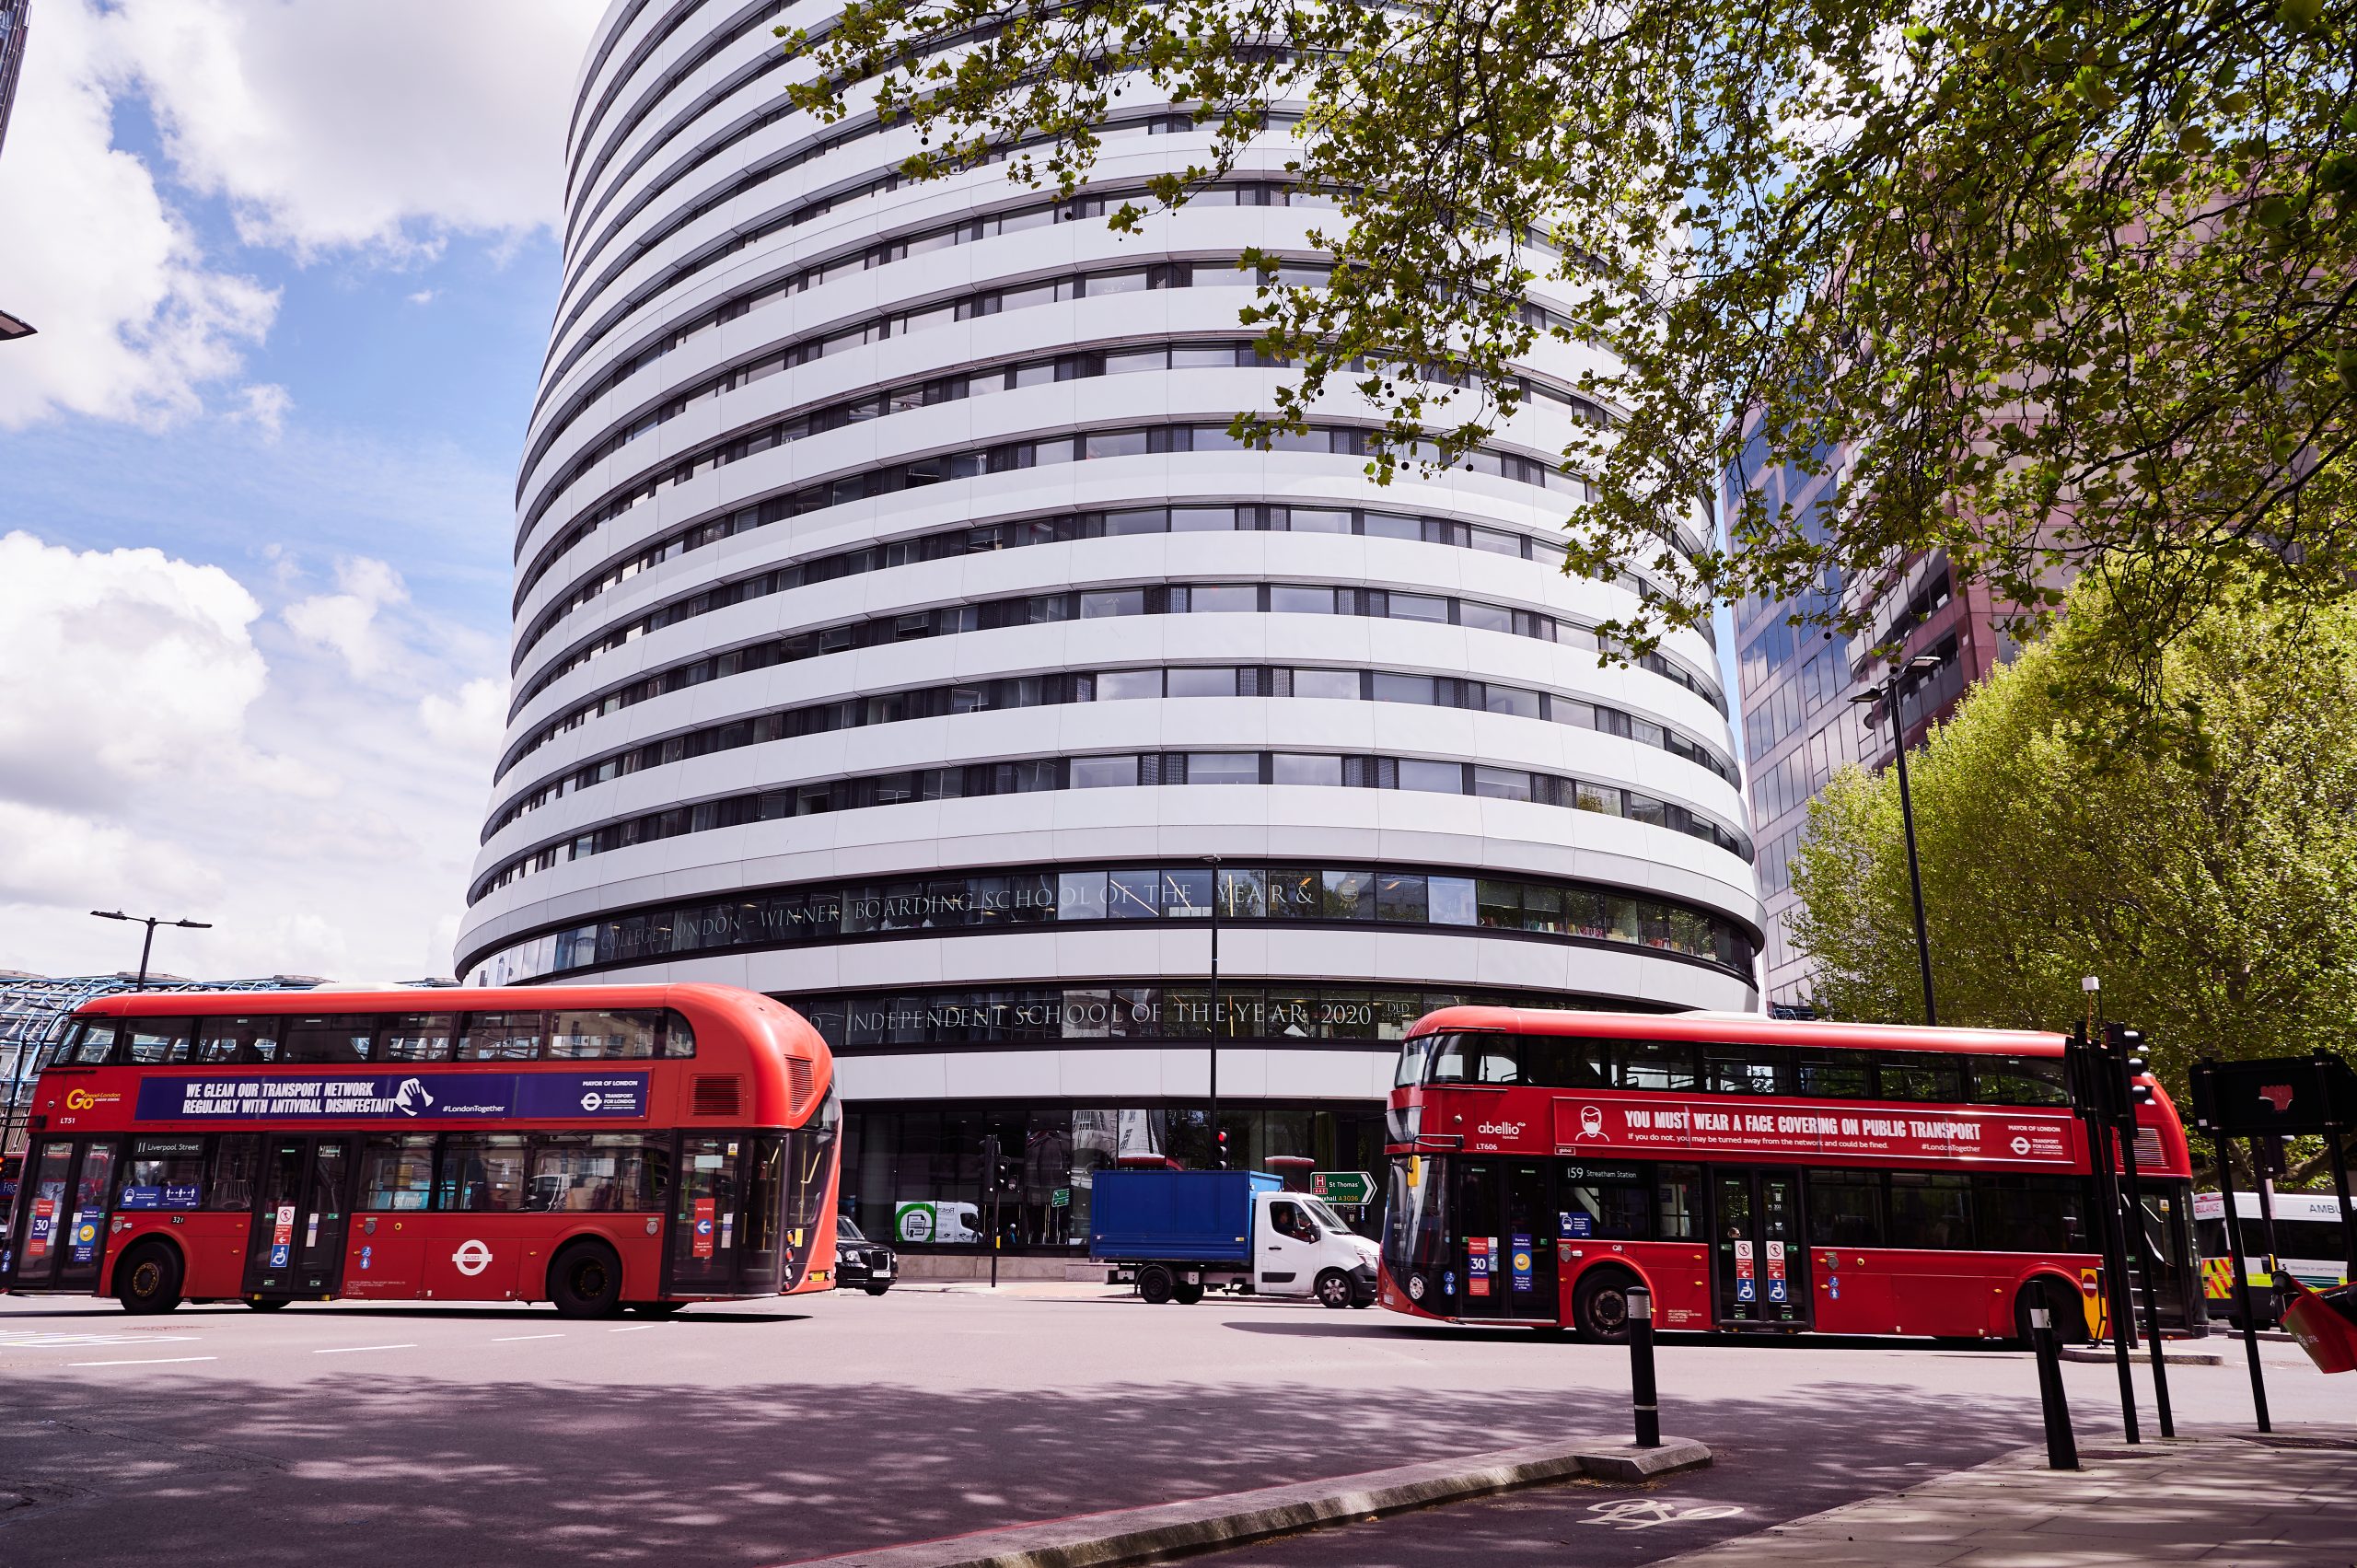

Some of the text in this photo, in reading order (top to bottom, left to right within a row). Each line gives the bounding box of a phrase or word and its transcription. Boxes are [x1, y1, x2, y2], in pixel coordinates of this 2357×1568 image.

[601, 924, 659, 950] COLLEGE
[664, 914, 741, 940] LONDON
[855, 893, 973, 919] BOARDING
[984, 887, 1091, 910] SCHOOL
[1099, 885, 1133, 905] OF
[1144, 885, 1191, 903] THE
[1217, 885, 1287, 903] YEAR
[1295, 886, 1316, 904] &
[1387, 1003, 1410, 1013] DLD
[846, 1007, 1005, 1032] INDEPENDENT
[1016, 1004, 1123, 1026] SCHOOL
[1132, 1004, 1162, 1024] OF
[1174, 1004, 1225, 1023] THE
[1234, 1004, 1306, 1024] YEAR
[1321, 1005, 1372, 1025] 2020
[186, 1082, 375, 1098] WE CLEAN OUR TRANSPORT NETWORK
[66, 1088, 95, 1110] Go
[182, 1098, 397, 1114] REGULARLY WITH ANTIVIRAL DISINFECTANT
[443, 1104, 505, 1114] #LondonTogether
[1478, 1121, 1520, 1134] abellio
[1624, 1110, 1981, 1141] YOU MUST WEAR A FACE COVERING ON PUBLIC TRANSPORT
[1634, 1134, 1648, 1143] you
[1676, 1136, 1690, 1144] you
[1692, 1136, 1706, 1144] may
[1708, 1135, 1717, 1144] be
[1718, 1135, 1742, 1144] turned
[1743, 1138, 1761, 1146] away
[1762, 1137, 1780, 1145] from
[1781, 1137, 1793, 1145] the
[1794, 1138, 1823, 1147] network
[1839, 1140, 1857, 1148] could
[1859, 1140, 1868, 1148] be
[147, 1144, 177, 1152] Liverpool
[1922, 1143, 1981, 1153] #LondonTogether
[1567, 1167, 1636, 1179] 159 Streatham Station
[1316, 1176, 1324, 1186] H
[2195, 1202, 2220, 1214] BULANCE
[34, 1219, 49, 1231] 30
[1470, 1258, 1487, 1271] 30
